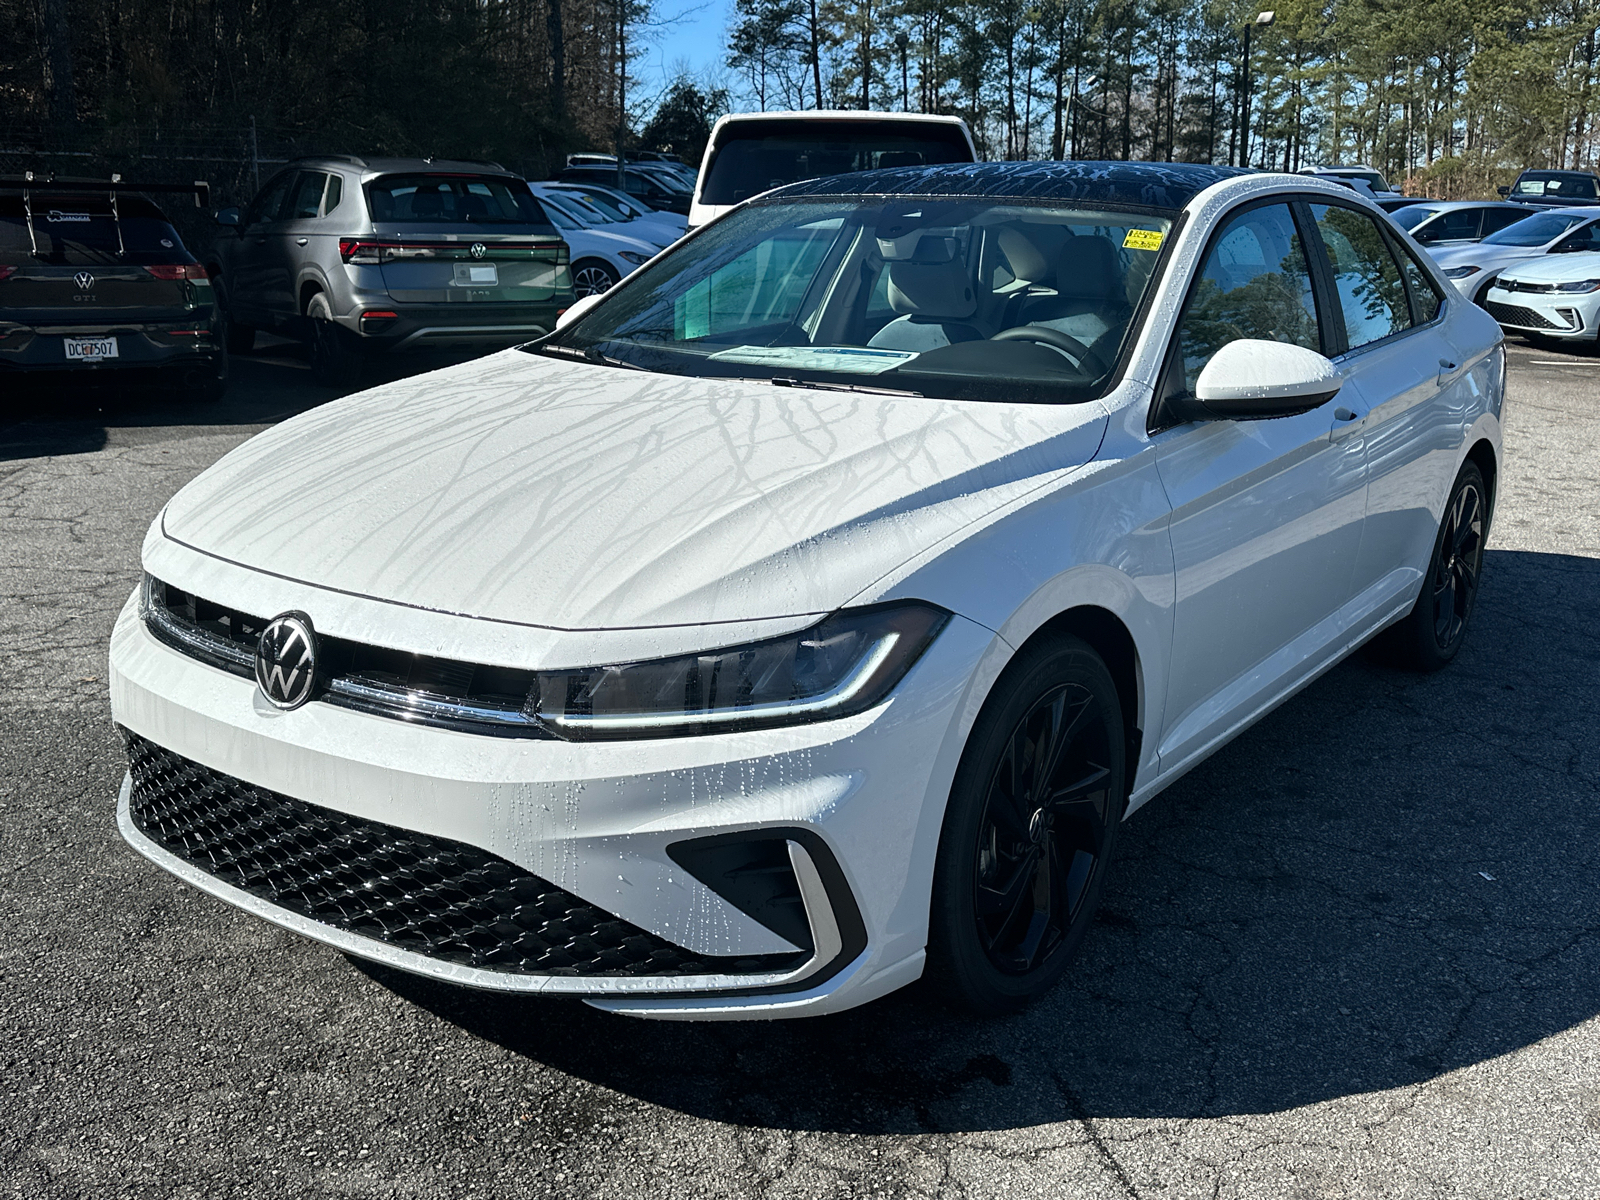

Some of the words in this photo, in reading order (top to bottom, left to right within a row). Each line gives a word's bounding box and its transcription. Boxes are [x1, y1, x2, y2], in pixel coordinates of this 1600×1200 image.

[73, 272, 94, 290] VW
[73, 295, 96, 303] GTI
[68, 342, 113, 356] DCE7507
[257, 613, 314, 707] VW
